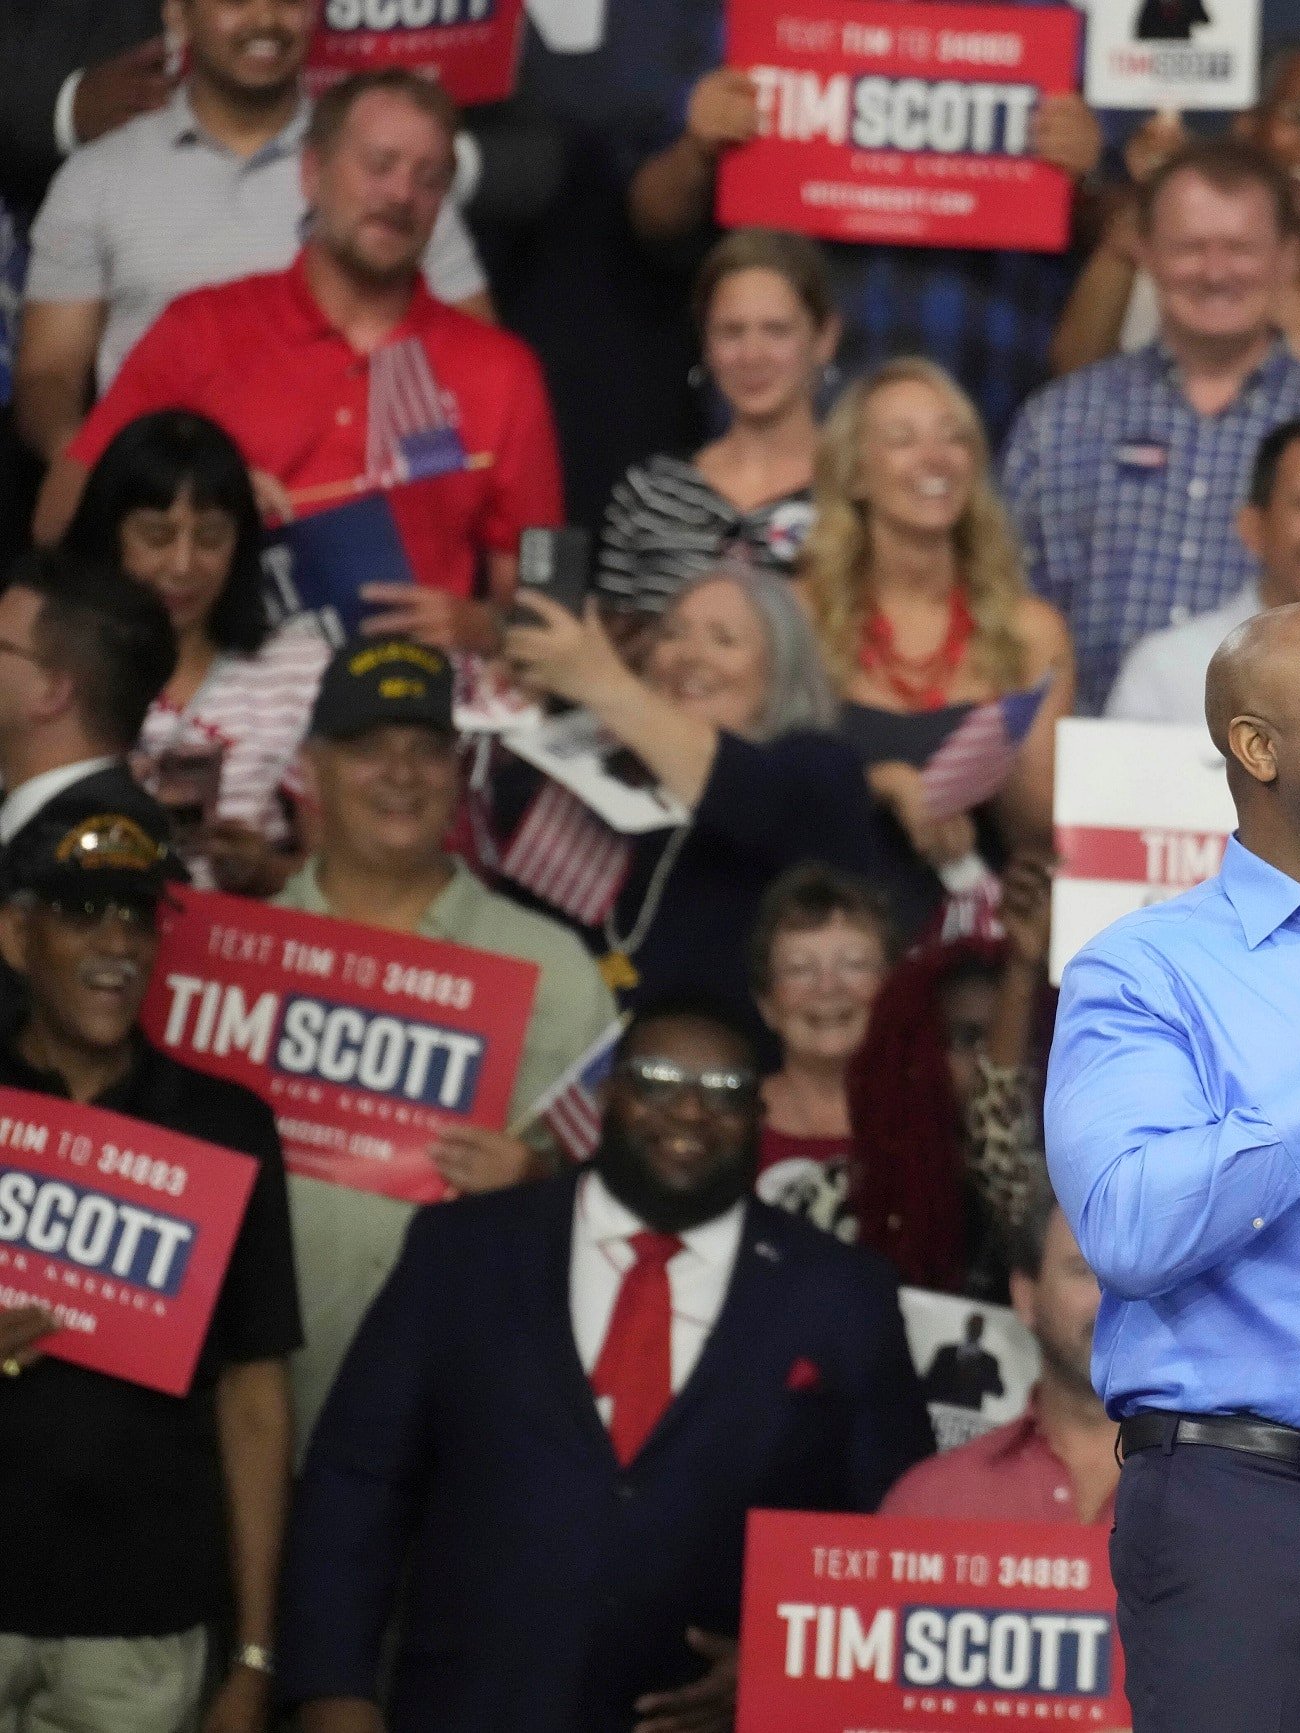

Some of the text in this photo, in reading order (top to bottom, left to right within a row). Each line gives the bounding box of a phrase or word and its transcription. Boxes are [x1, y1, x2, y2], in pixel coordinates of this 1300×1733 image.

[752, 66, 1037, 155] TIM SCOTT
[208, 924, 273, 964] TEXT
[283, 939, 334, 978] TIM
[341, 952, 378, 988] TO
[165, 973, 483, 1109] TIM SCOTT
[57, 1130, 93, 1167] TO
[0, 1171, 193, 1290] SCOTT
[813, 1547, 880, 1580] TEXT
[890, 1550, 944, 1584] TIM
[954, 1553, 991, 1587] TO
[776, 1602, 1110, 1693] TIM SCOTT
